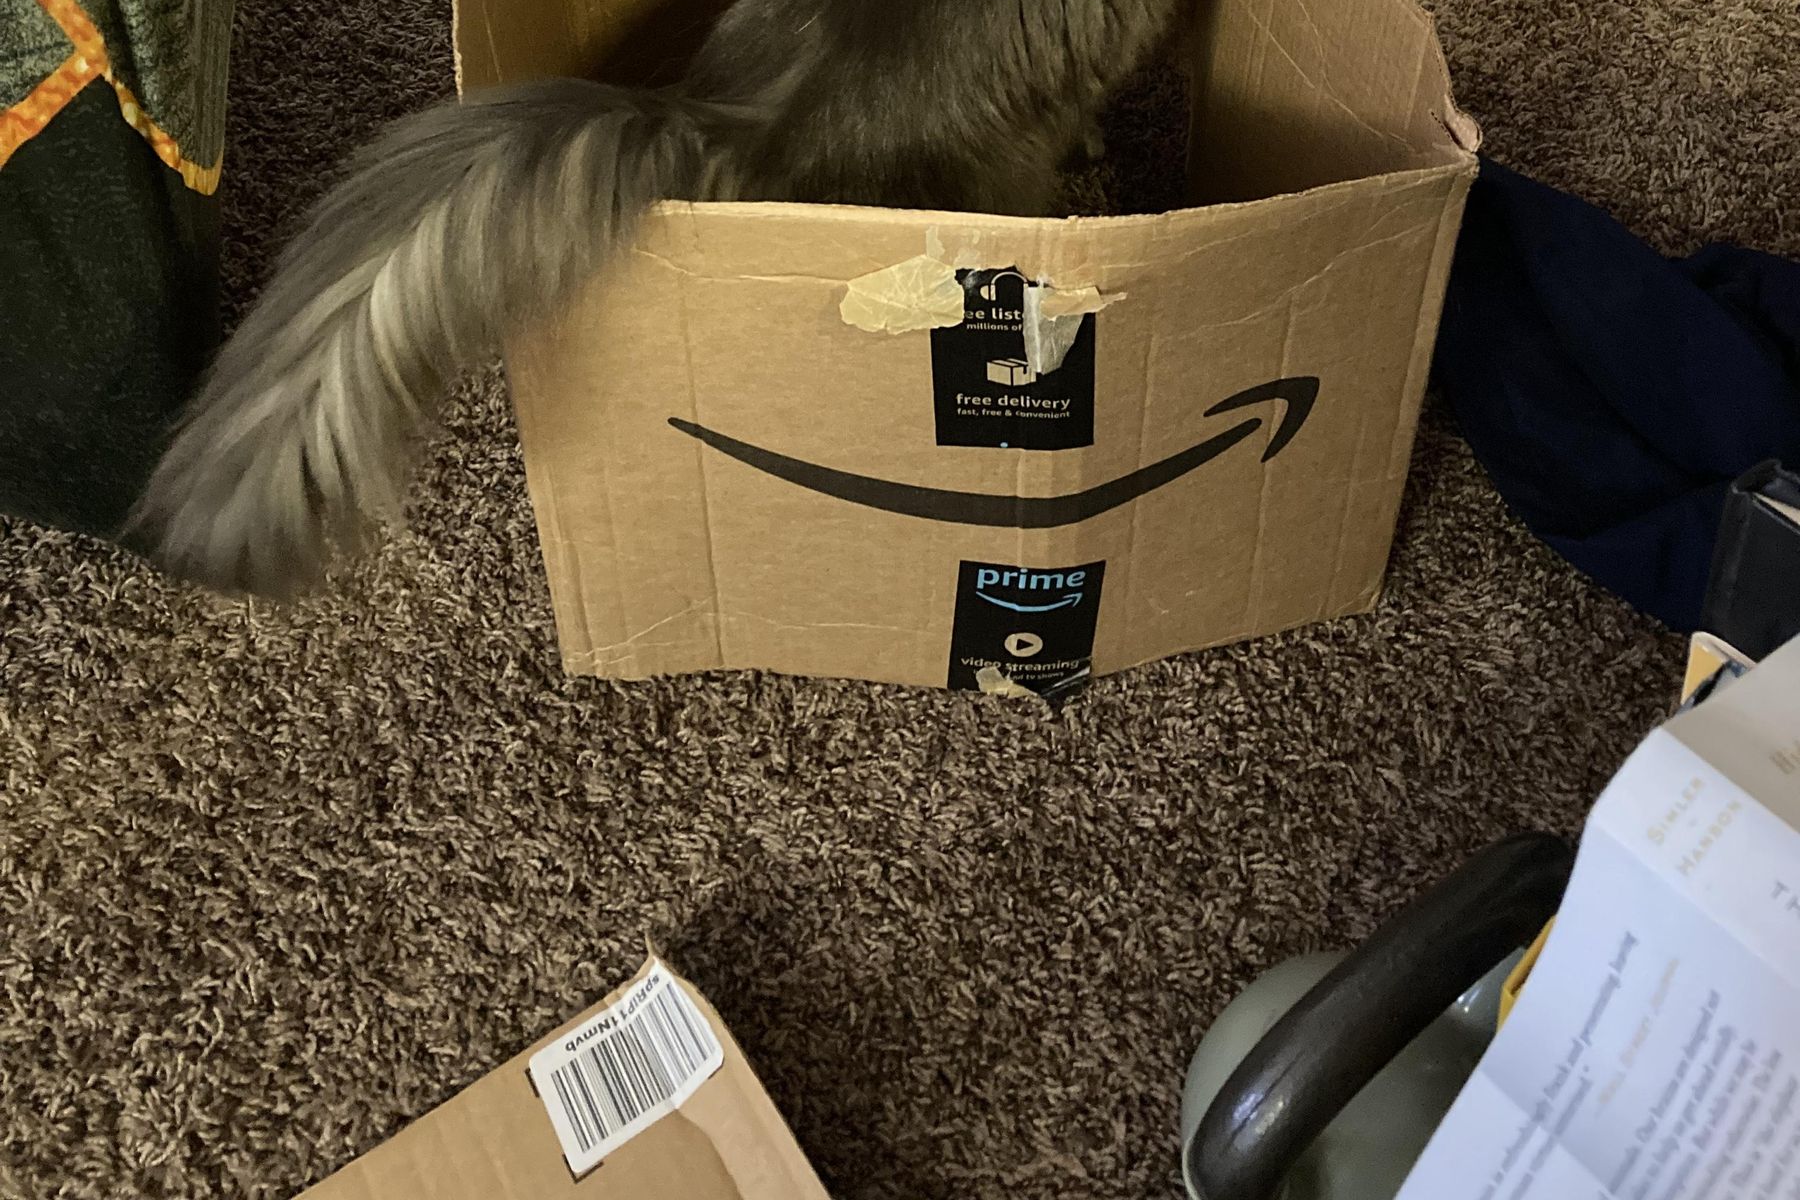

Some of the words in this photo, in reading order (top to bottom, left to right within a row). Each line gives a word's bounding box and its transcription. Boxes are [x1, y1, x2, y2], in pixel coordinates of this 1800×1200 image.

[991, 308, 1024, 320] list
[966, 323, 1009, 331] millions
[1011, 323, 1023, 331] of
[956, 393, 992, 406] free
[998, 394, 1071, 410] delivery
[957, 408, 979, 417] fast,
[982, 408, 1002, 416] free
[1005, 409, 1012, 417] &
[1015, 410, 1071, 419] convenient
[977, 568, 1086, 590] prime
[960, 656, 1000, 668] video
[1006, 659, 1080, 672] streaming
